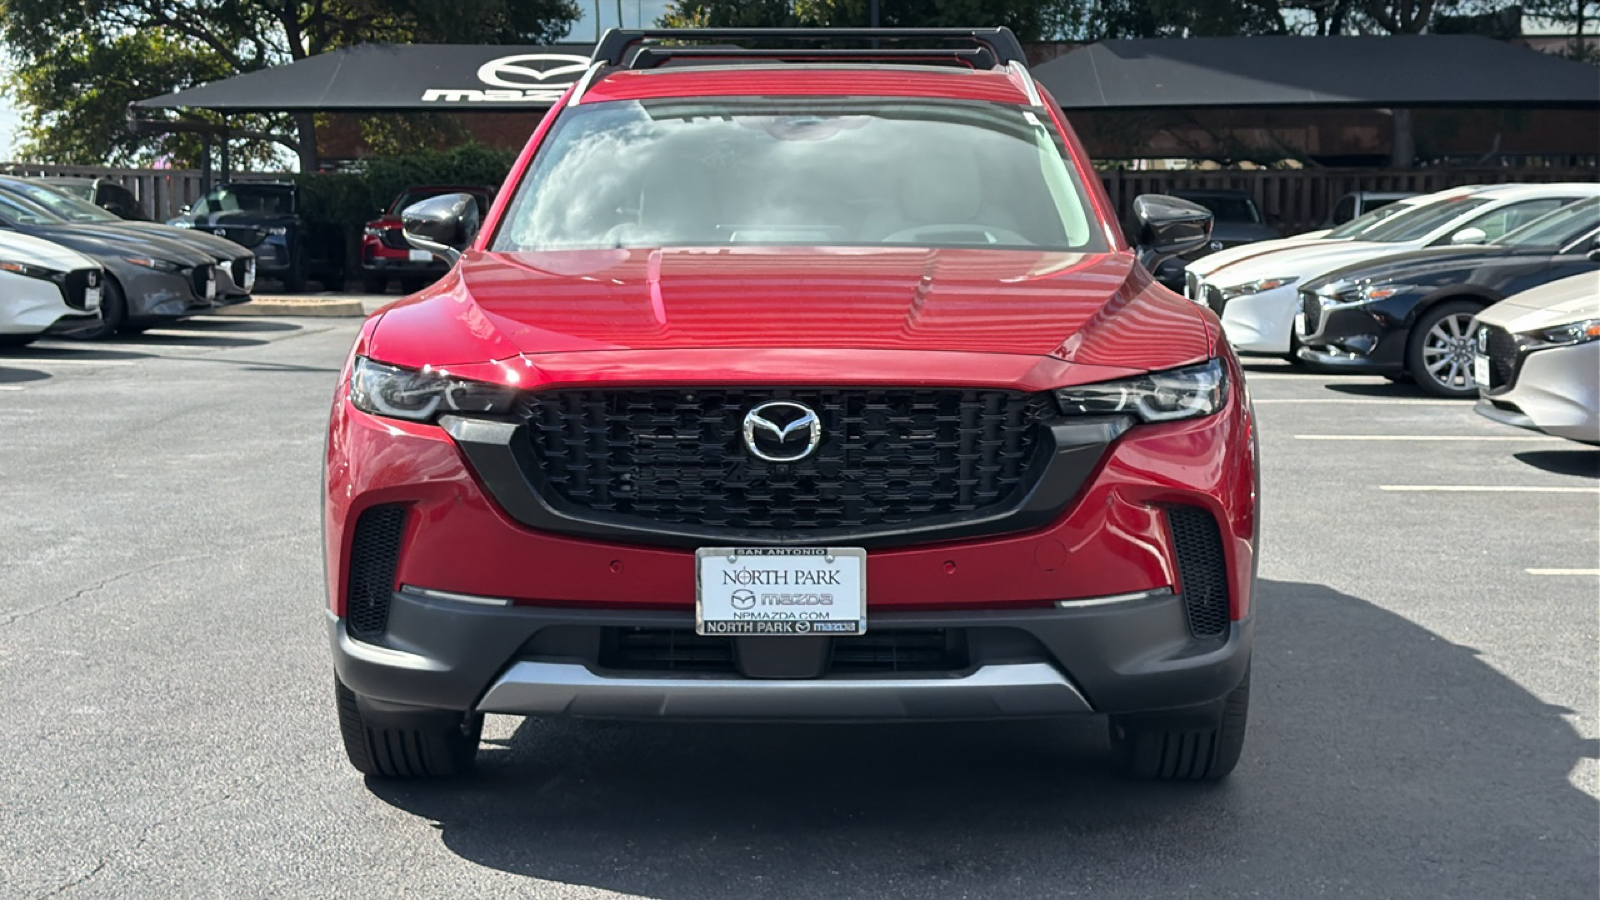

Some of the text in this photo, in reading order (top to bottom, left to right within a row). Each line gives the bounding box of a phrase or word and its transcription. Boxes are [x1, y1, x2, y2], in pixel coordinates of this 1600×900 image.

[421, 88, 565, 101] maz
[722, 567, 840, 586] NORTH PARK
[733, 611, 829, 620] NPMAZDA.COM
[707, 621, 855, 632] NORTH PARK mazda
